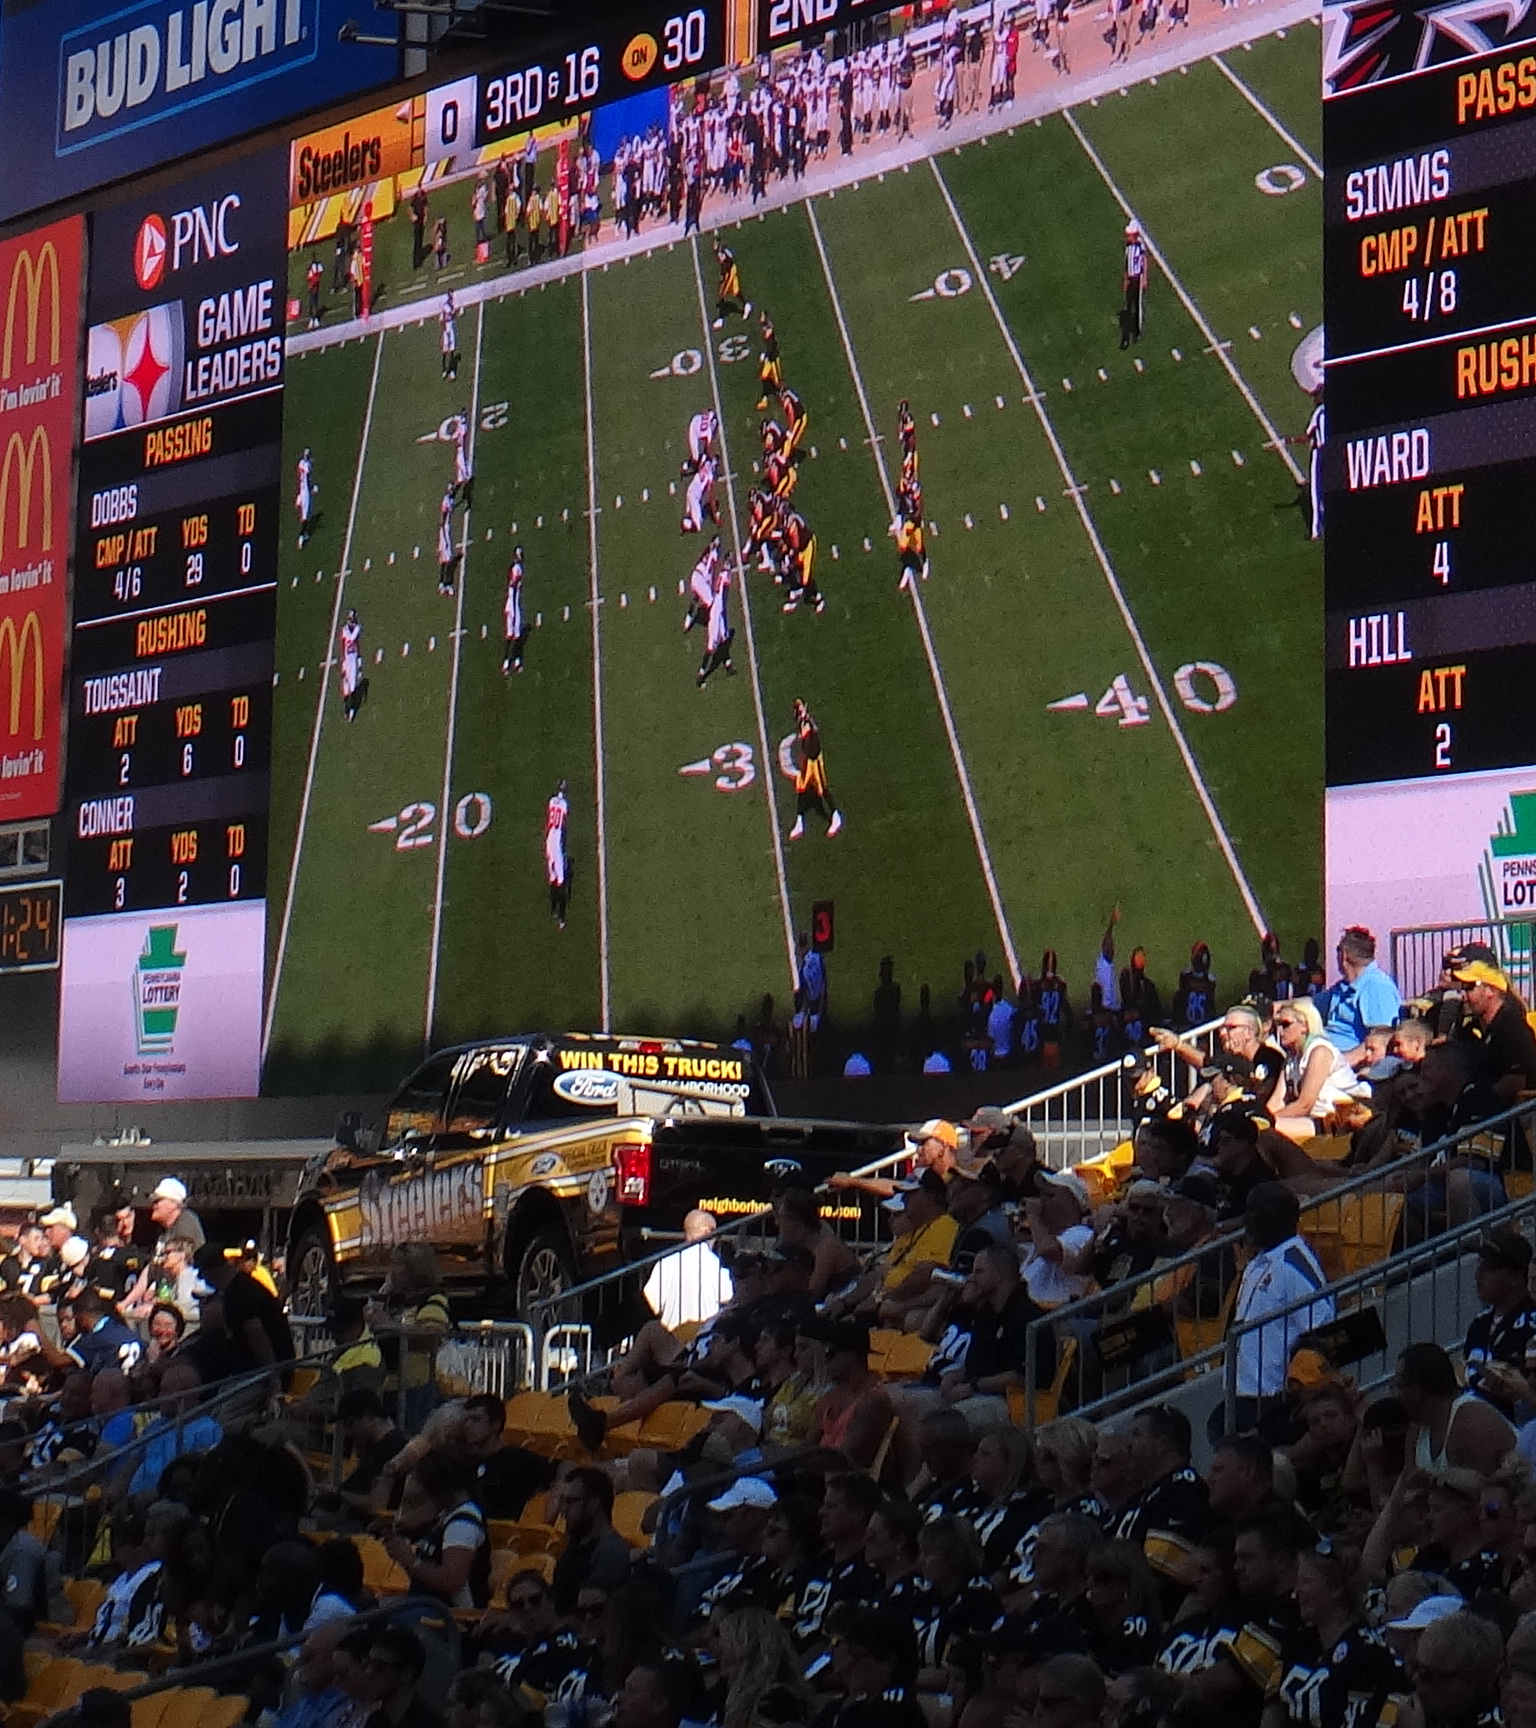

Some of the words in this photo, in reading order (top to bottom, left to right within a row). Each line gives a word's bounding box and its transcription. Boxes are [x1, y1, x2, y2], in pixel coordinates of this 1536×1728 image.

[64, 24, 160, 133] BUD
[484, 66, 543, 131] 3RD
[564, 45, 600, 104] 16
[630, 46, 649, 68] ON
[663, 9, 706, 71] 30
[440, 101, 459, 141] 0
[298, 134, 381, 198] Steelers
[1346, 149, 1450, 220] SIMMS
[172, 194, 240, 268] PNC
[1402, 270, 1457, 321] 4/8
[197, 280, 274, 349] GAME
[185, 337, 281, 402] LEADERS
[0, 386, 17, 412] i'm
[50, 373, 61, 399] it
[145, 417, 212, 467] PASSING
[1346, 427, 1430, 490] WARD
[91, 485, 138, 528] DOBBS
[237, 503, 255, 535] TD
[1416, 483, 1464, 533] ATT
[182, 513, 208, 547] YDS
[42, 557, 53, 583] it
[186, 553, 203, 585] 29
[241, 542, 251, 573] 0
[1433, 542, 1450, 584] 4
[114, 565, 142, 601] 4/6
[136, 609, 207, 658] RUSHING
[1348, 611, 1412, 667] HILL
[84, 667, 161, 714] TOUSSAINT
[1417, 664, 1466, 713] ATT
[176, 704, 201, 738] YDS
[232, 696, 248, 729] TD
[114, 715, 138, 747] ATT
[1435, 723, 1451, 768] 2
[33, 748, 44, 773] it
[182, 743, 192, 774] 6
[234, 735, 244, 767] 0
[119, 754, 129, 785] 2
[78, 795, 134, 839] CONNER
[109, 838, 132, 870] ATT
[171, 830, 197, 864] YDS
[228, 824, 244, 858] TD
[114, 878, 125, 908] 3
[177, 871, 188, 903] 2
[229, 864, 240, 897] 0
[143, 984, 181, 1004] LOTTERY
[560, 1050, 603, 1071] WIN
[608, 1052, 659, 1077] THIS
[664, 1056, 743, 1080] TRUCK!
[570, 1075, 616, 1098] Ford
